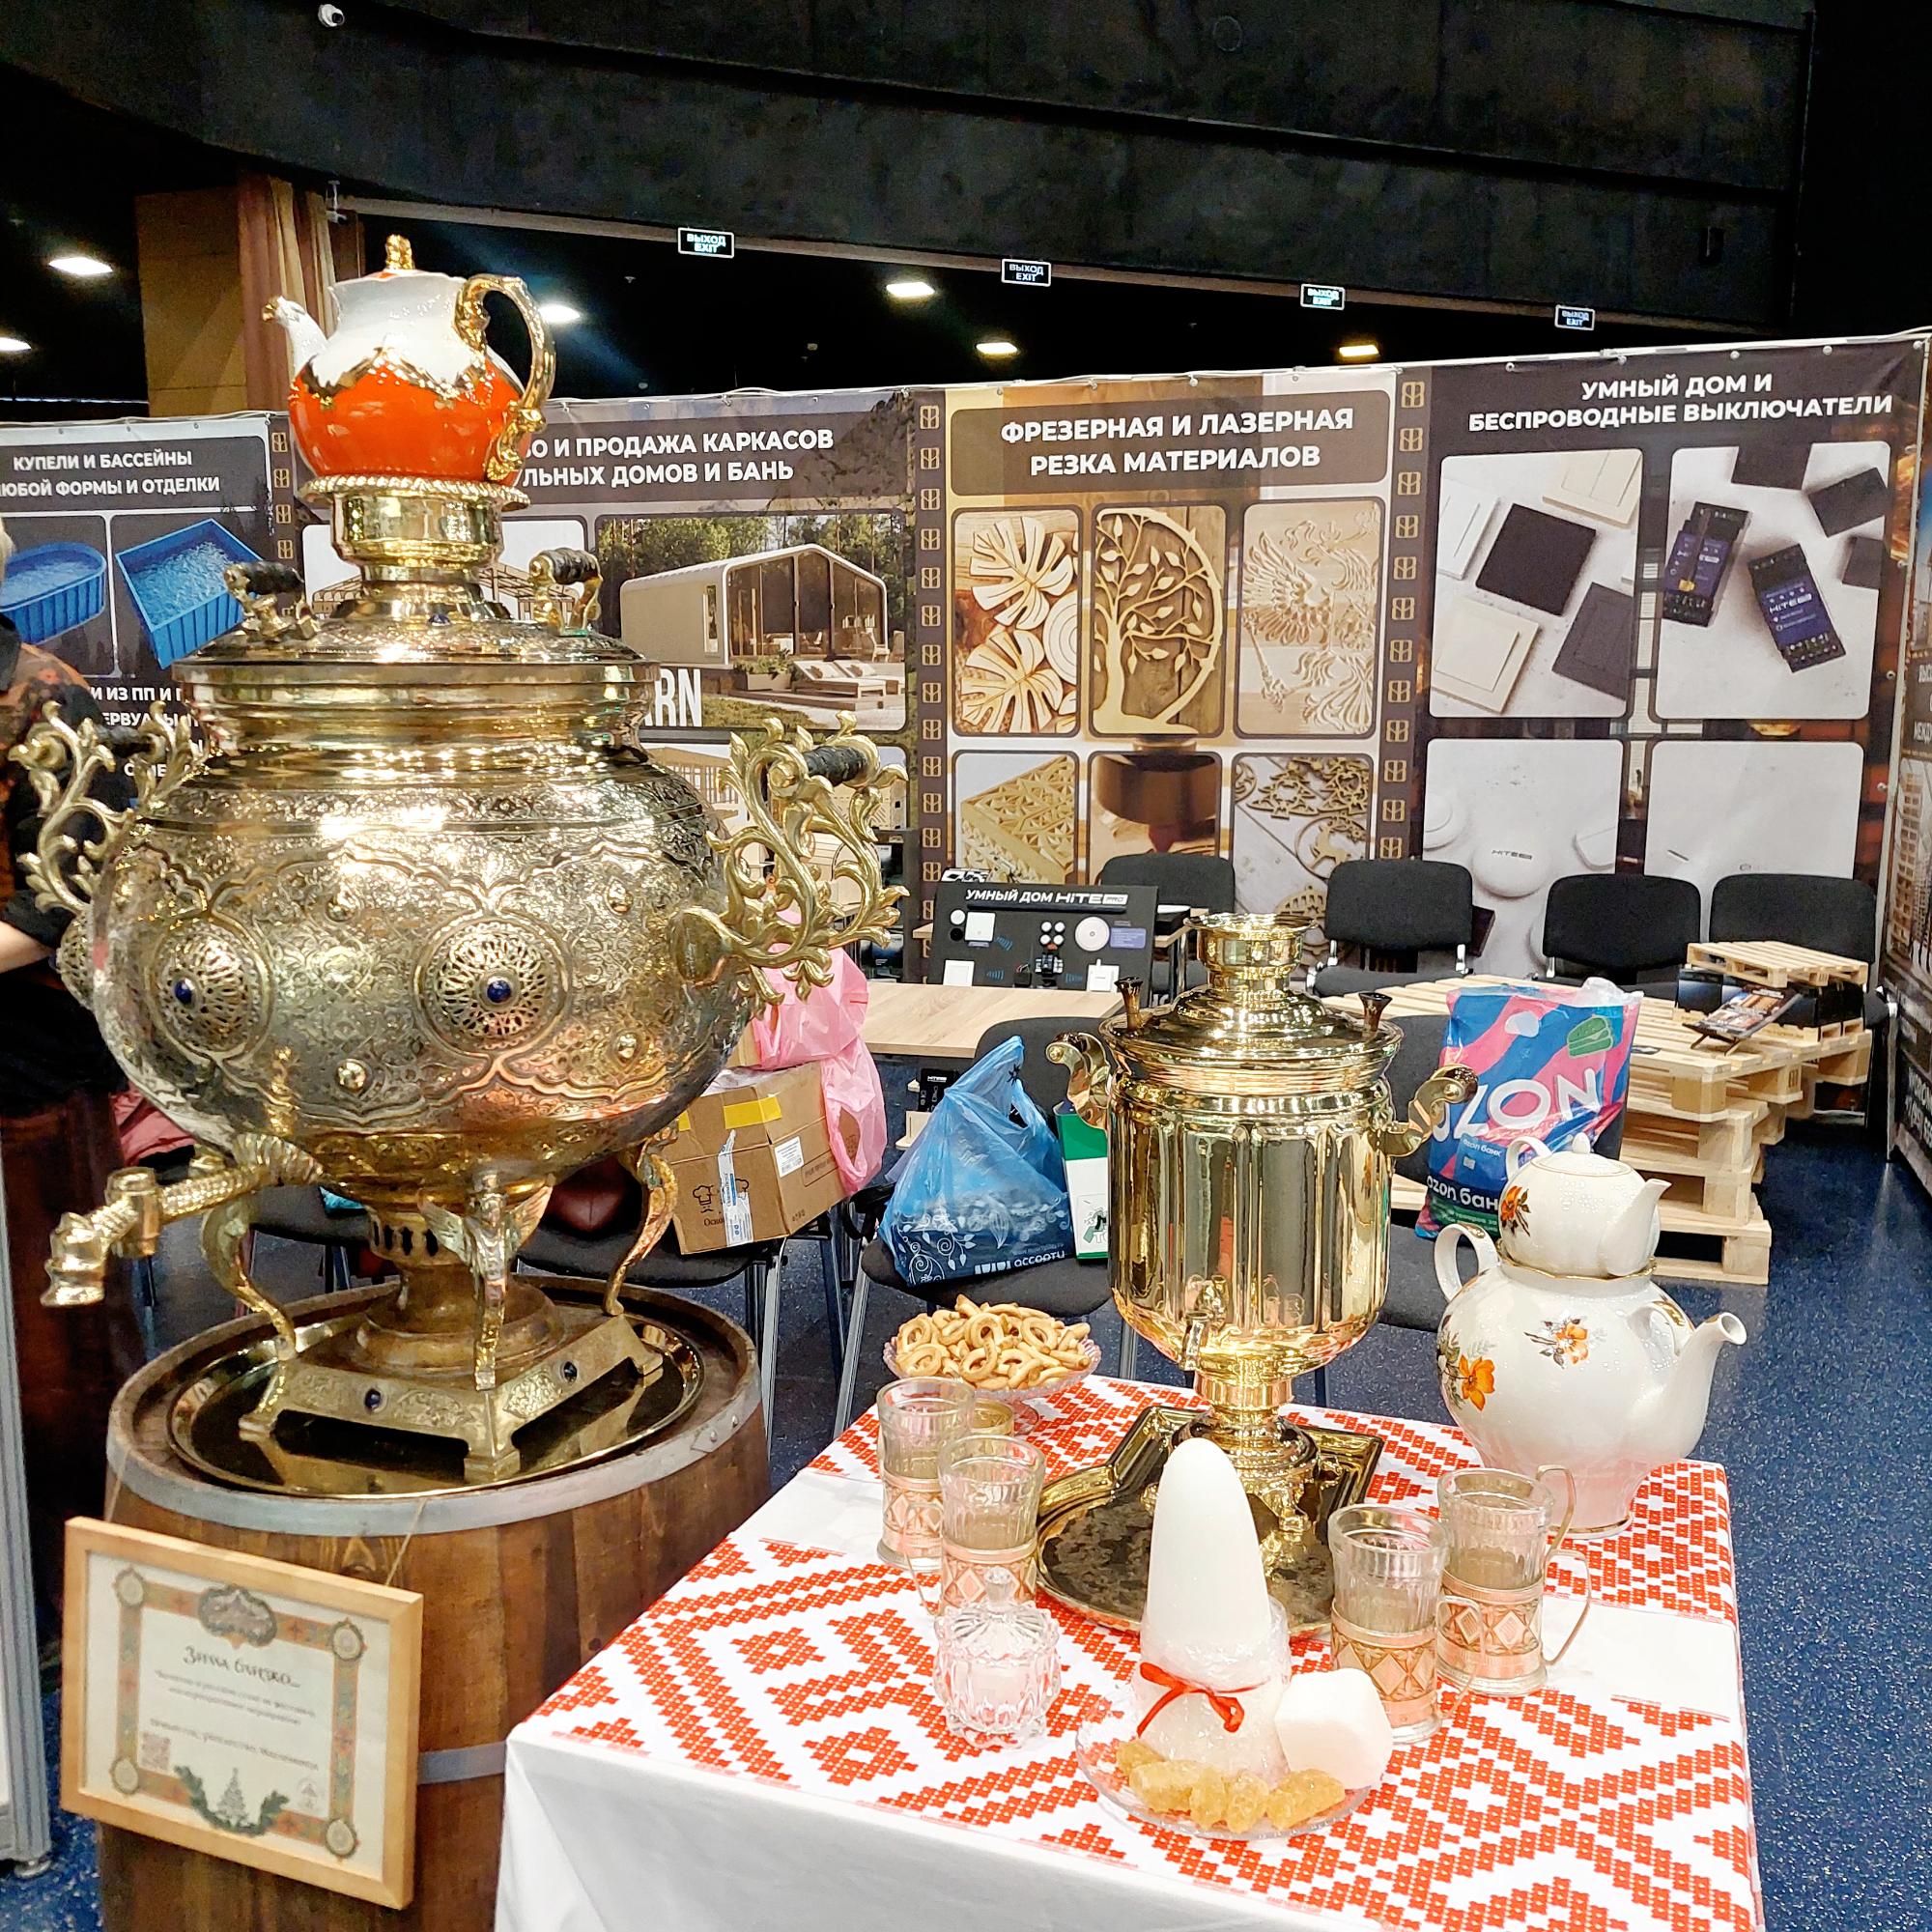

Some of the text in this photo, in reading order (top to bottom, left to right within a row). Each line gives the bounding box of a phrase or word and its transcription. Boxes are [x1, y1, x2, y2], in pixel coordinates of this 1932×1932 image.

[687, 233, 726, 247] ВЫХОД
[695, 242, 718, 253] EXIT
[1009, 264, 1044, 276] ВЫХОД
[1016, 272, 1037, 281] EXIT
[1581, 374, 1772, 401] УМНЫЙ ДОМ И
[1468, 395, 1892, 432] БЕСПРОВОДНЫЕ ВЫКЛЮЧАТЕЛИ
[1001, 408, 1353, 443] ФРЕЗЕРНАЯ И ЛАЗЕРНАЯ
[554, 438, 570, 458] И
[576, 434, 697, 458] ПРОДАЖА
[702, 429, 834, 453] КАРКАСОВ
[14, 449, 192, 470] КУПЕЛИ И БАССЕЙНЫ
[1031, 445, 1321, 476] РЕЗКА МАТЕРИАЛОВ
[611, 464, 697, 488] ДОМОВ
[704, 463, 721, 482] И
[727, 461, 793, 481] БАНЬ
[0, 477, 220, 497] ЮБОЙ ФОРМЫ И ОТДЕЛКИ
[106, 687, 128, 701] ИЗ
[131, 687, 156, 701] ПП
[159, 687, 172, 701] И
[966, 889, 1017, 901] УМНЫЙ
[1019, 892, 1053, 903] ДОМ
[1481, 1144, 1503, 1157] банк
[1427, 1176, 1457, 1201] ozon
[1460, 1187, 1499, 1211] бан
